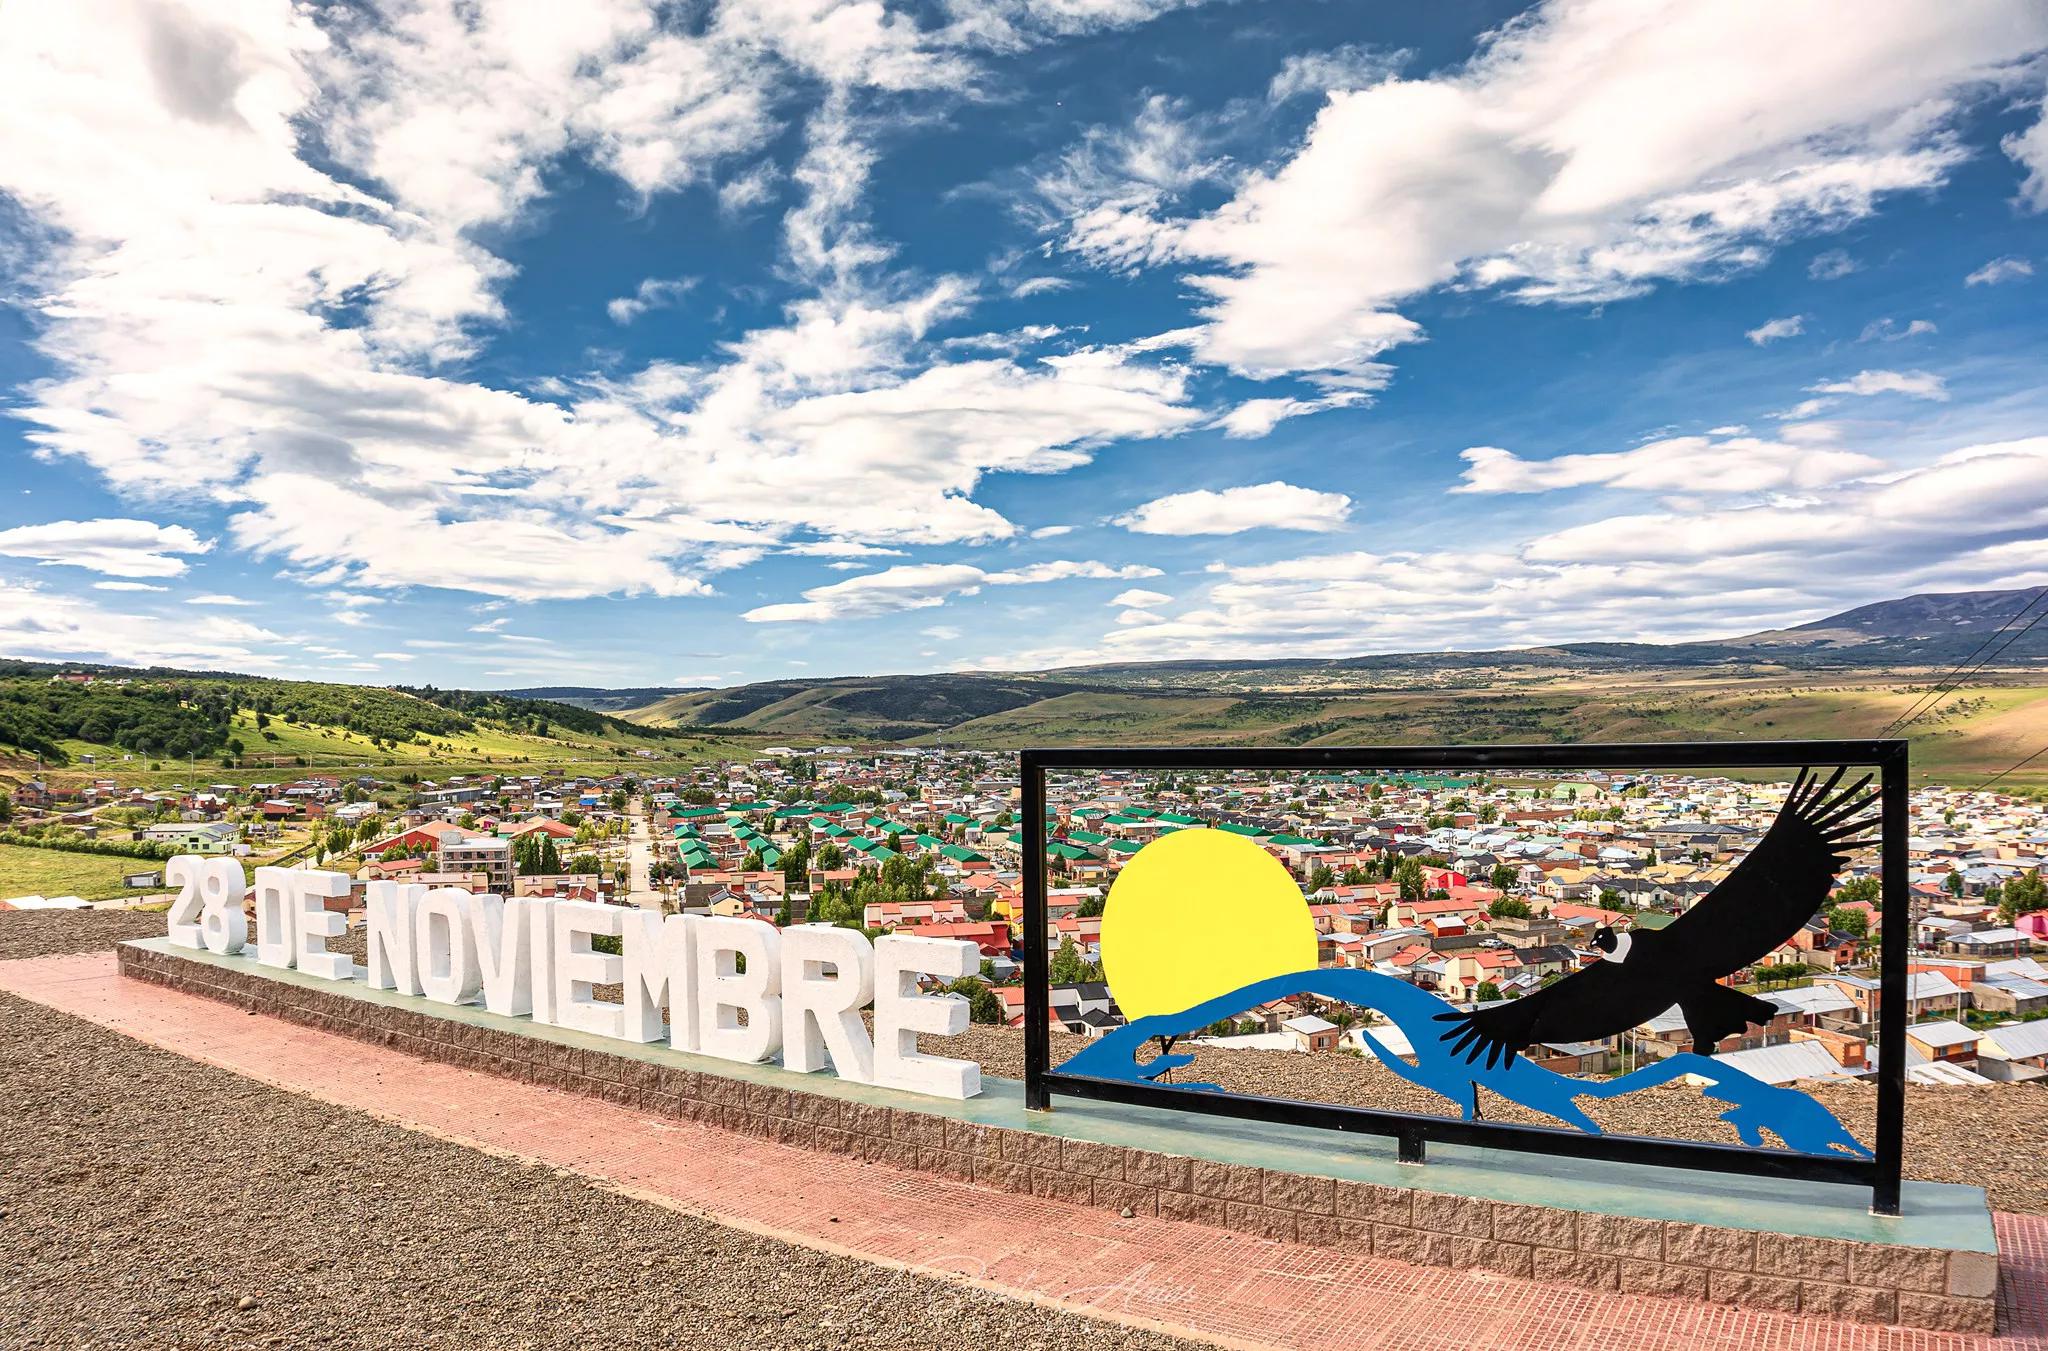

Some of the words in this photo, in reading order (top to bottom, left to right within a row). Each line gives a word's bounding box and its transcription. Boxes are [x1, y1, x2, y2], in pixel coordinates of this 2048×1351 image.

[165, 854, 247, 956] 28
[255, 866, 353, 981] DE
[367, 880, 983, 1099] NOVIEMBRE
